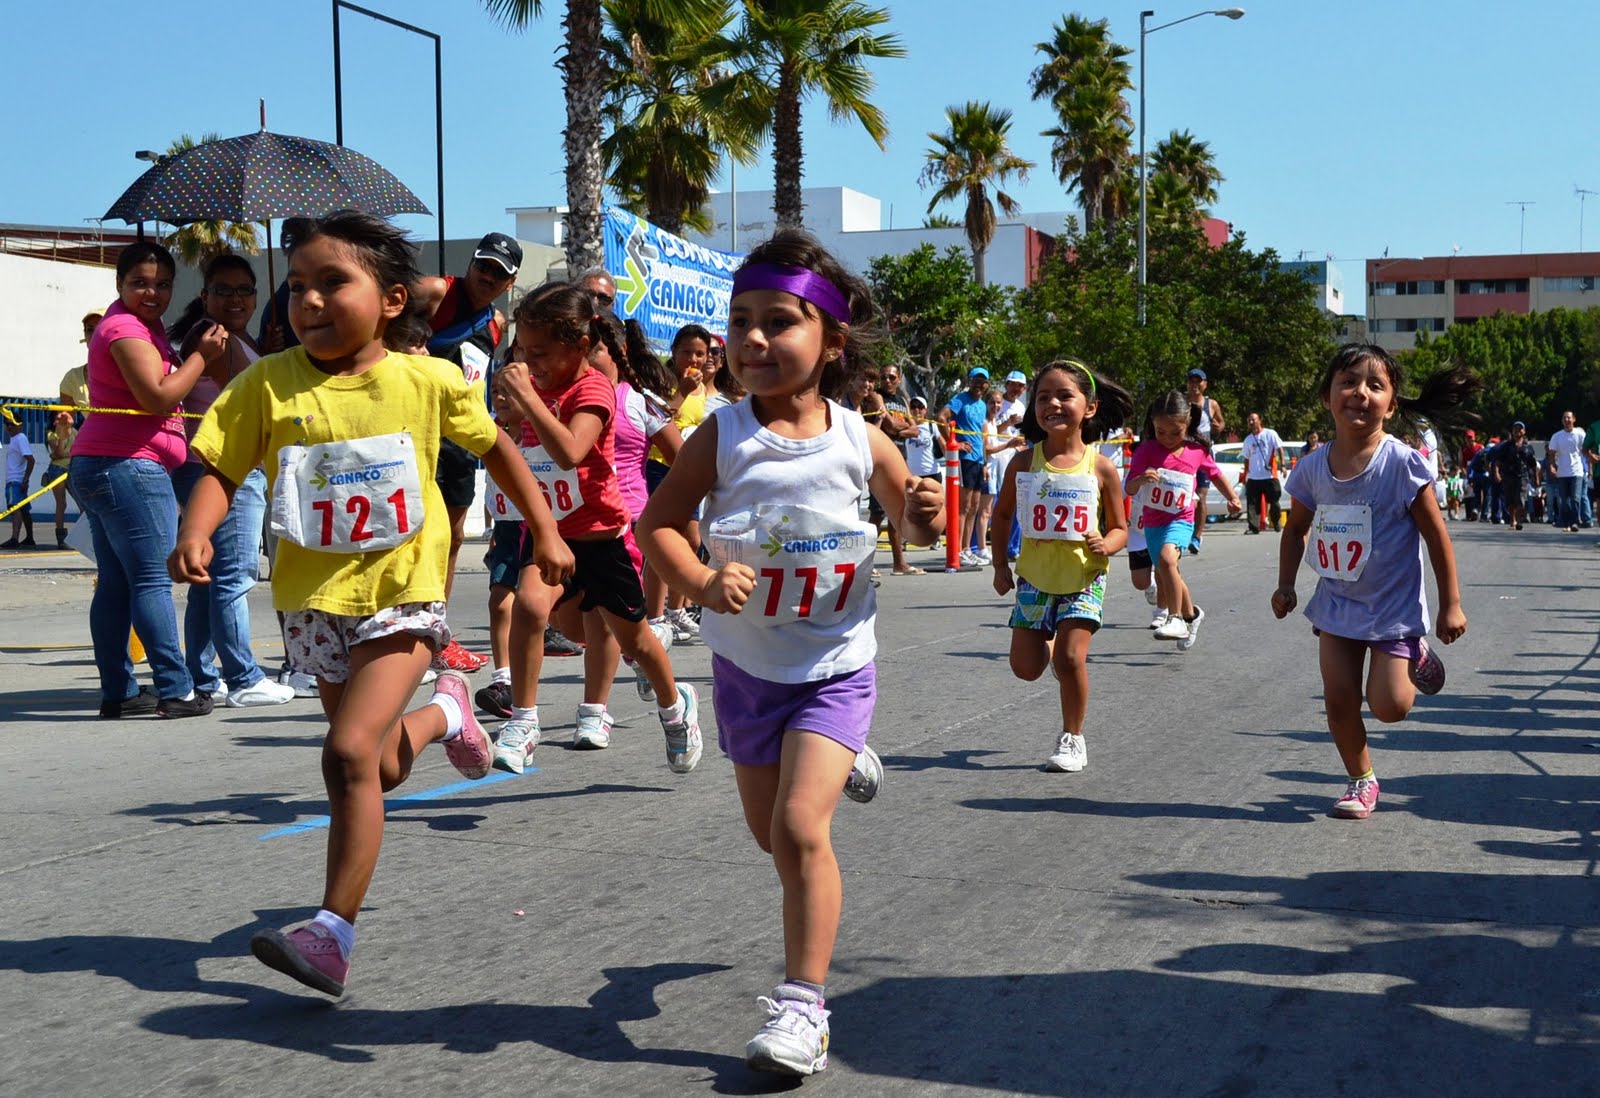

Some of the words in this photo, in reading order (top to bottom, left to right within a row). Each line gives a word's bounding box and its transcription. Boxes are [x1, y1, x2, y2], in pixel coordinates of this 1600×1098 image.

[650, 278, 716, 317] CANACO
[329, 469, 381, 485] CANACO
[381, 465, 407, 479] 2011
[537, 480, 573, 511] 68
[1048, 490, 1078, 499] CANACO
[1151, 487, 1186, 510] 904
[312, 487, 409, 547] 721
[1033, 504, 1088, 533] 825
[783, 538, 838, 553] CANACO
[838, 536, 867, 550] 2011
[1317, 539, 1363, 572] 812
[760, 563, 856, 618] 777
